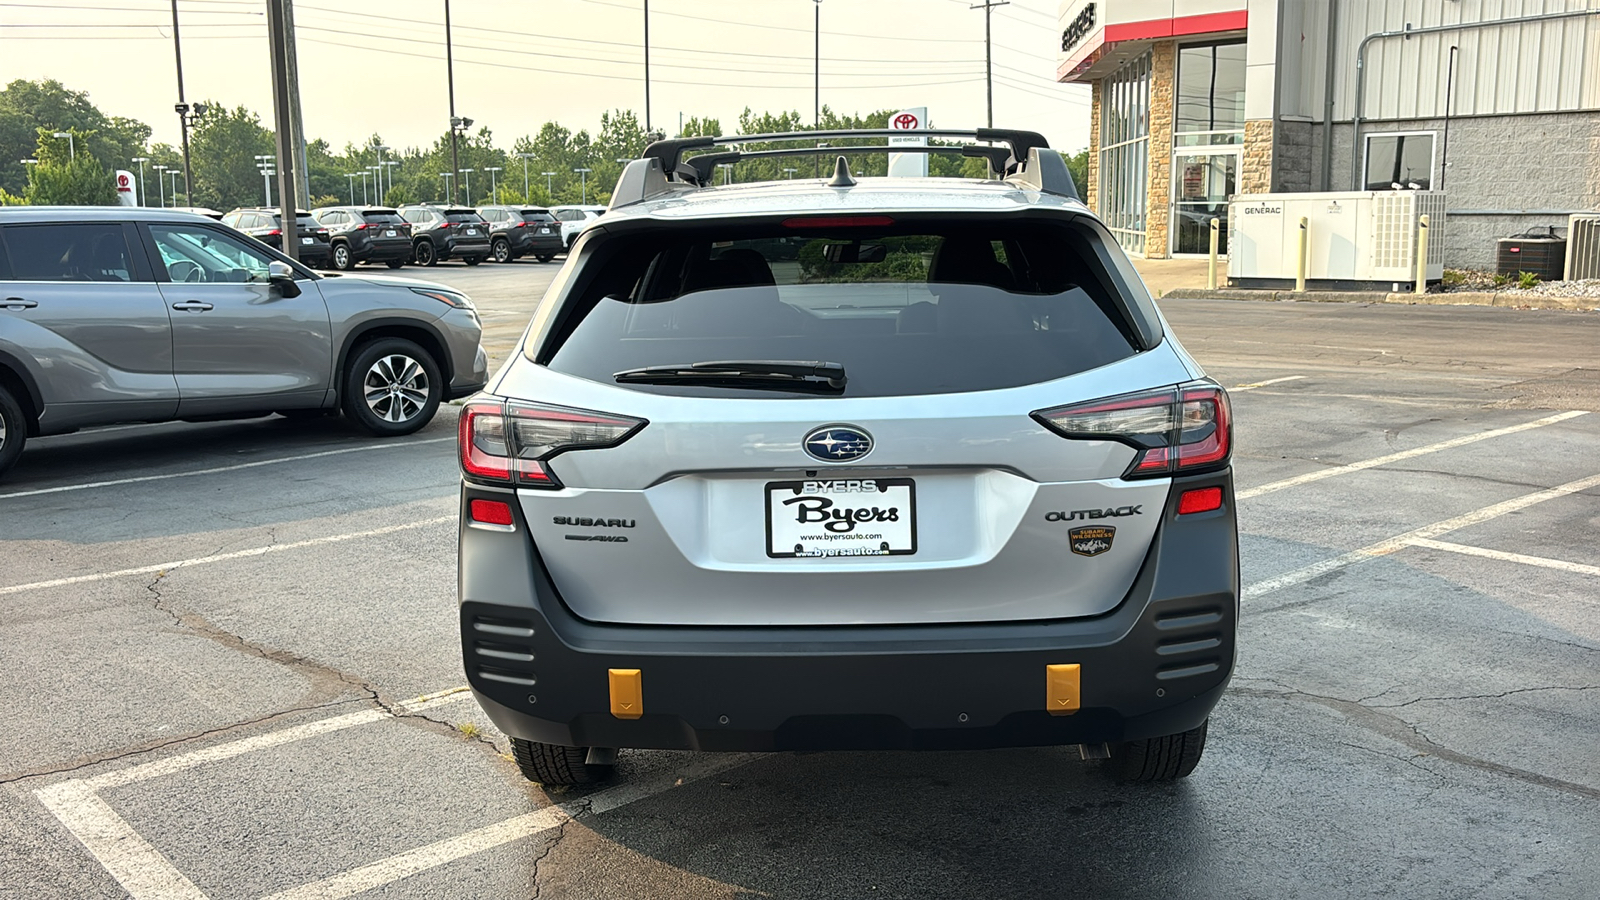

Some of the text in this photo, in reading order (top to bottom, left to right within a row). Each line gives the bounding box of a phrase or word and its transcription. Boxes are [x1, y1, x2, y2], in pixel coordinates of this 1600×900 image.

[803, 480, 877, 493] BYERS
[782, 496, 899, 533] Byers
[1045, 504, 1143, 522] OUTBACK
[553, 515, 636, 528] SUBARU
[588, 535, 629, 543] AWD
[800, 533, 882, 542] www.byersauto.com
[795, 546, 889, 559] www.byersauto.com
